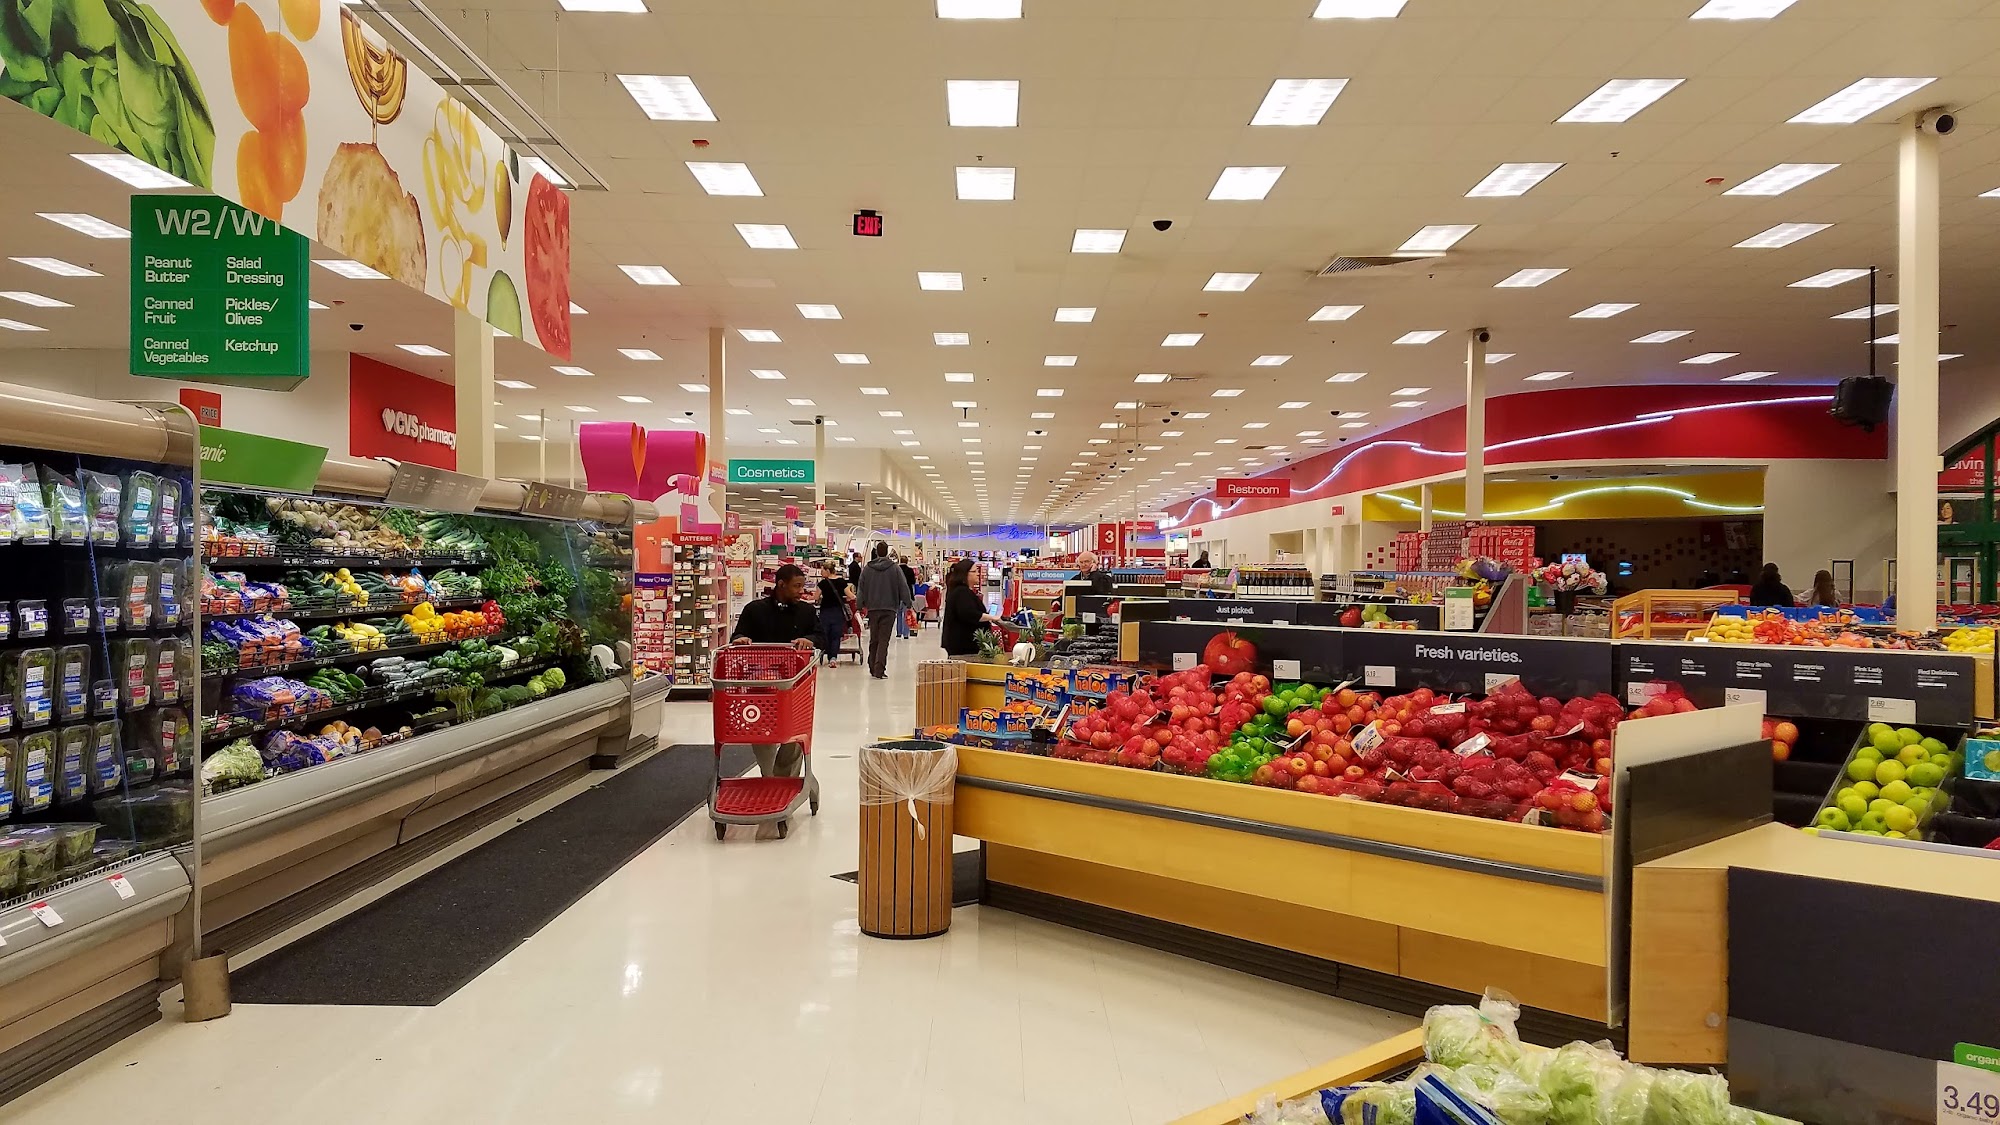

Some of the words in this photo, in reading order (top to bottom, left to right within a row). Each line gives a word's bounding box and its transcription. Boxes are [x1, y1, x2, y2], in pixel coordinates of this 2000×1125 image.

[857, 216, 880, 235] EXIT
[145, 256, 192, 269] Peanut
[226, 256, 262, 269] Salad
[145, 270, 190, 283] Butter
[226, 272, 284, 287] Dressing
[144, 297, 194, 310] Canned
[225, 298, 279, 312] Pickles/
[144, 312, 177, 324] Fruit
[225, 312, 263, 325] Olives
[144, 337, 189, 350] Canned
[225, 339, 279, 355] Ketchup
[144, 351, 209, 366] Vegetables
[201, 407, 218, 419] PRICE
[394, 411, 419, 438] CVS
[418, 421, 457, 450] pharmacy
[737, 466, 805, 478] Cosmetics
[1228, 484, 1280, 495] Restroom
[1104, 530, 1115, 544] 3
[1041, 571, 1065, 579] chosen
[1215, 605, 1230, 614] Just
[1230, 606, 1255, 615] picked.
[1415, 644, 1454, 660] Fresh
[1457, 647, 1523, 663] varieties.
[1008, 680, 1029, 695] halos
[1075, 674, 1107, 694] halos
[1036, 687, 1057, 703] halos
[1629, 687, 1642, 696] 3.42
[966, 713, 998, 733] halos
[1943, 1085, 2000, 1119] 3.49
